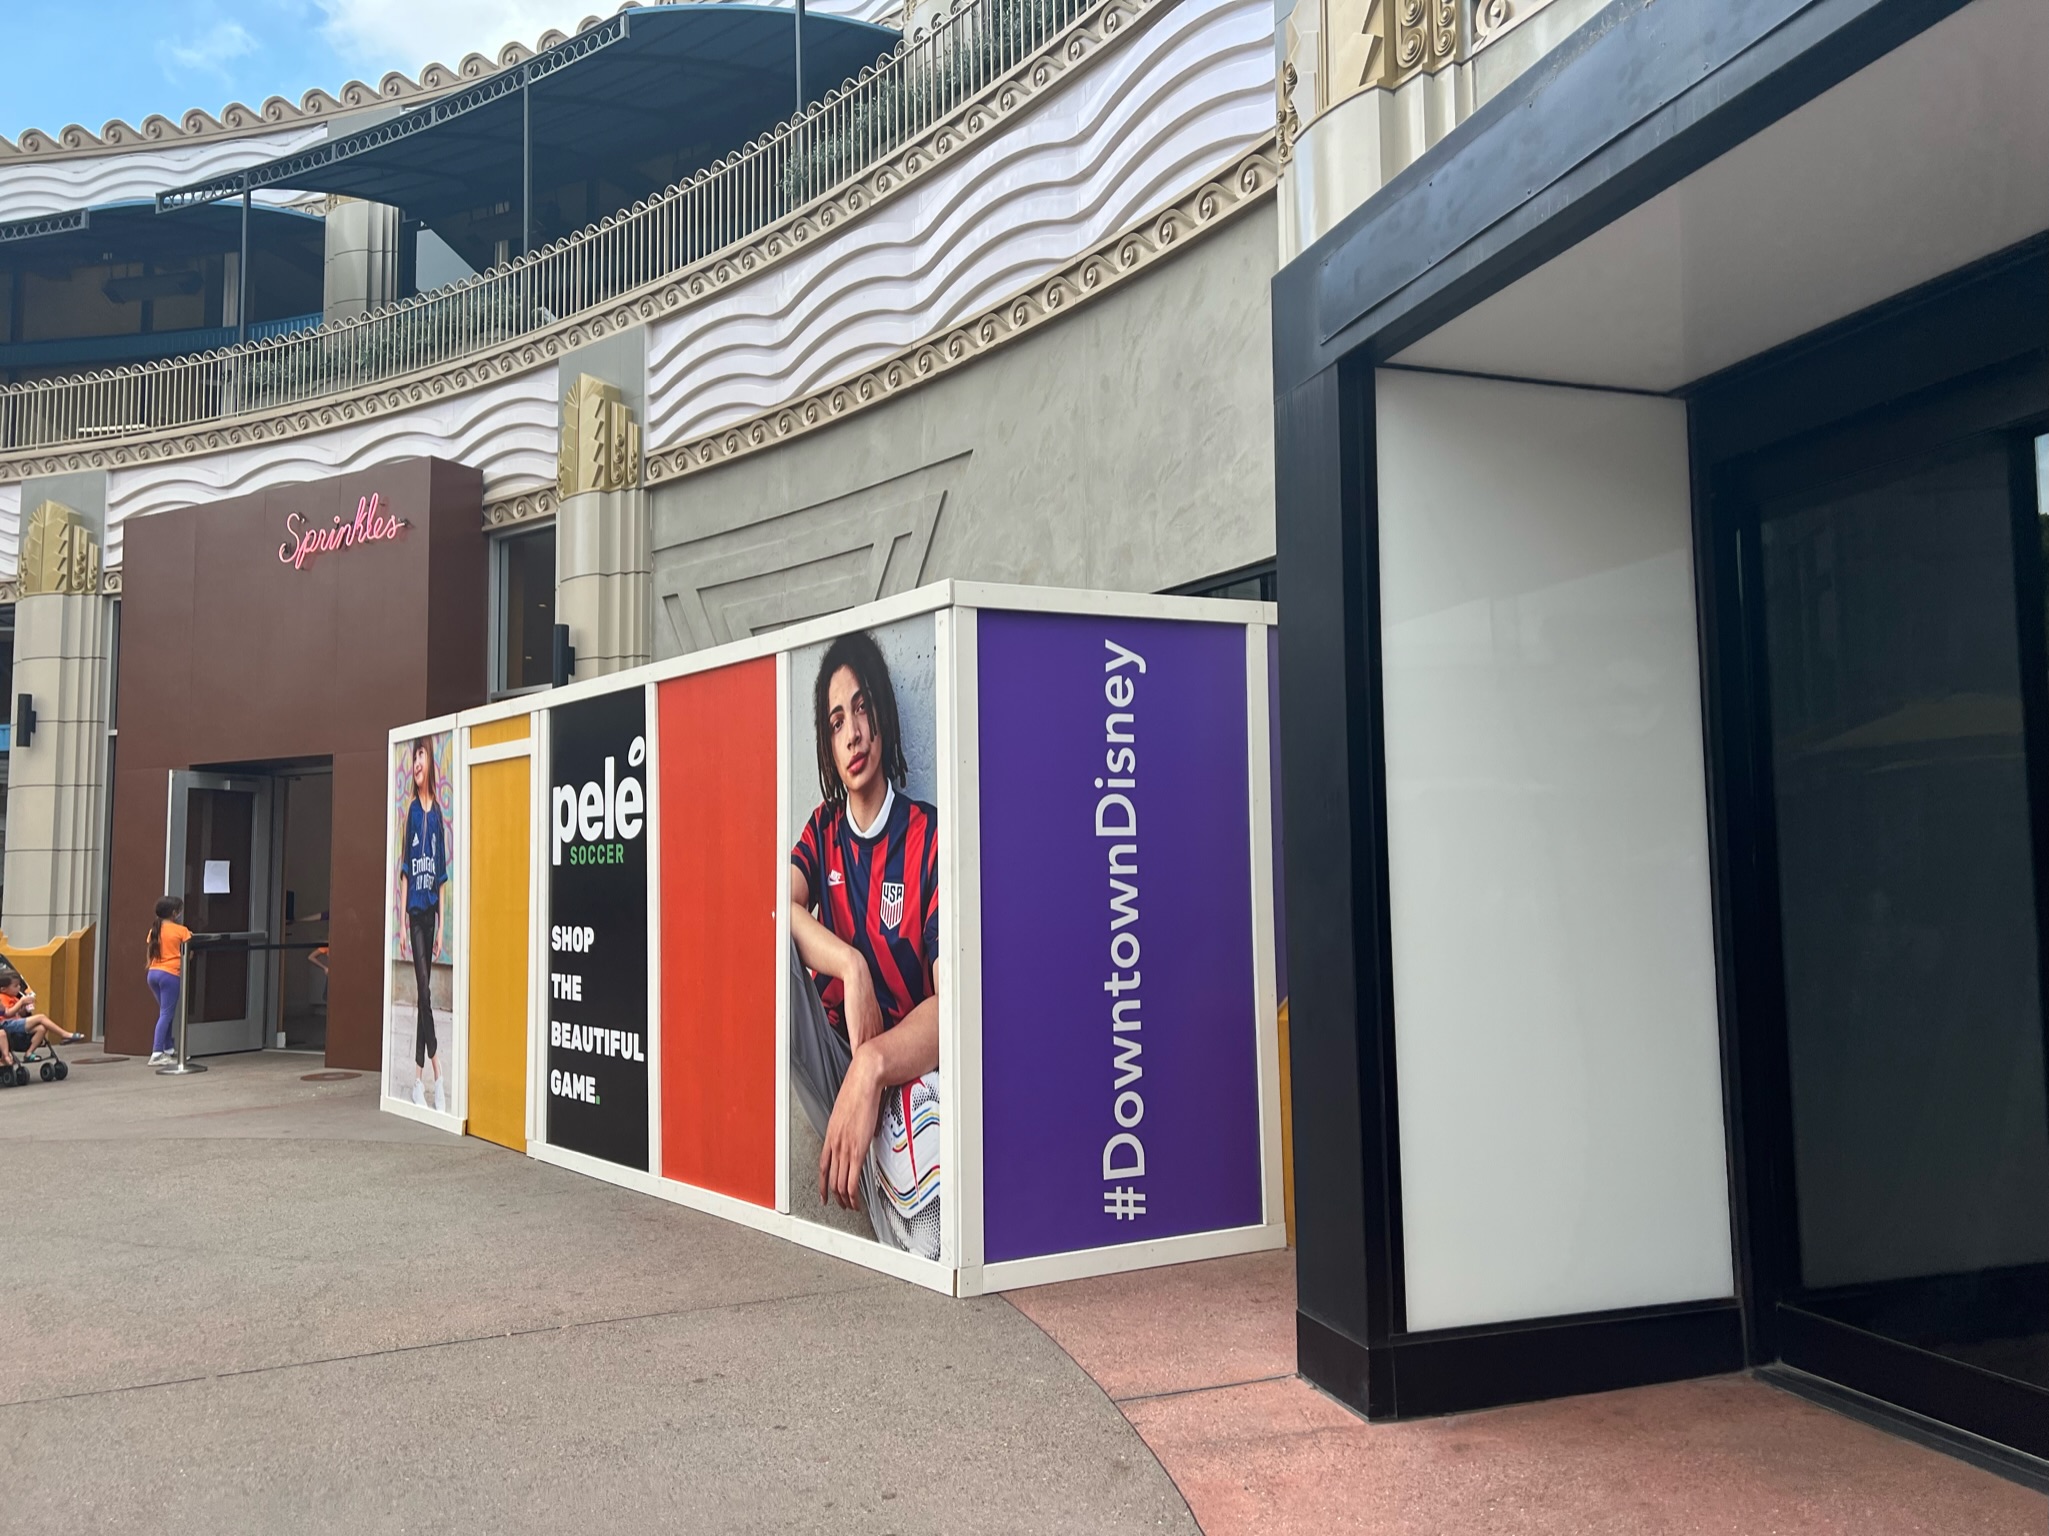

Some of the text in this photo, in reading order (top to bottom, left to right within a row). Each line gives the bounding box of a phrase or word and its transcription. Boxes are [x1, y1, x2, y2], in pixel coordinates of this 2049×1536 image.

[279, 492, 405, 569] Sprinkles
[570, 843, 624, 866] SOCCER
[883, 885, 902, 903] USA
[551, 925, 595, 953] SHOP
[1094, 638, 1147, 1221] #DowntownDisney
[551, 973, 582, 1002] THE
[551, 1020, 645, 1062] BEAUTIFUL
[550, 1069, 601, 1105] GAME.
